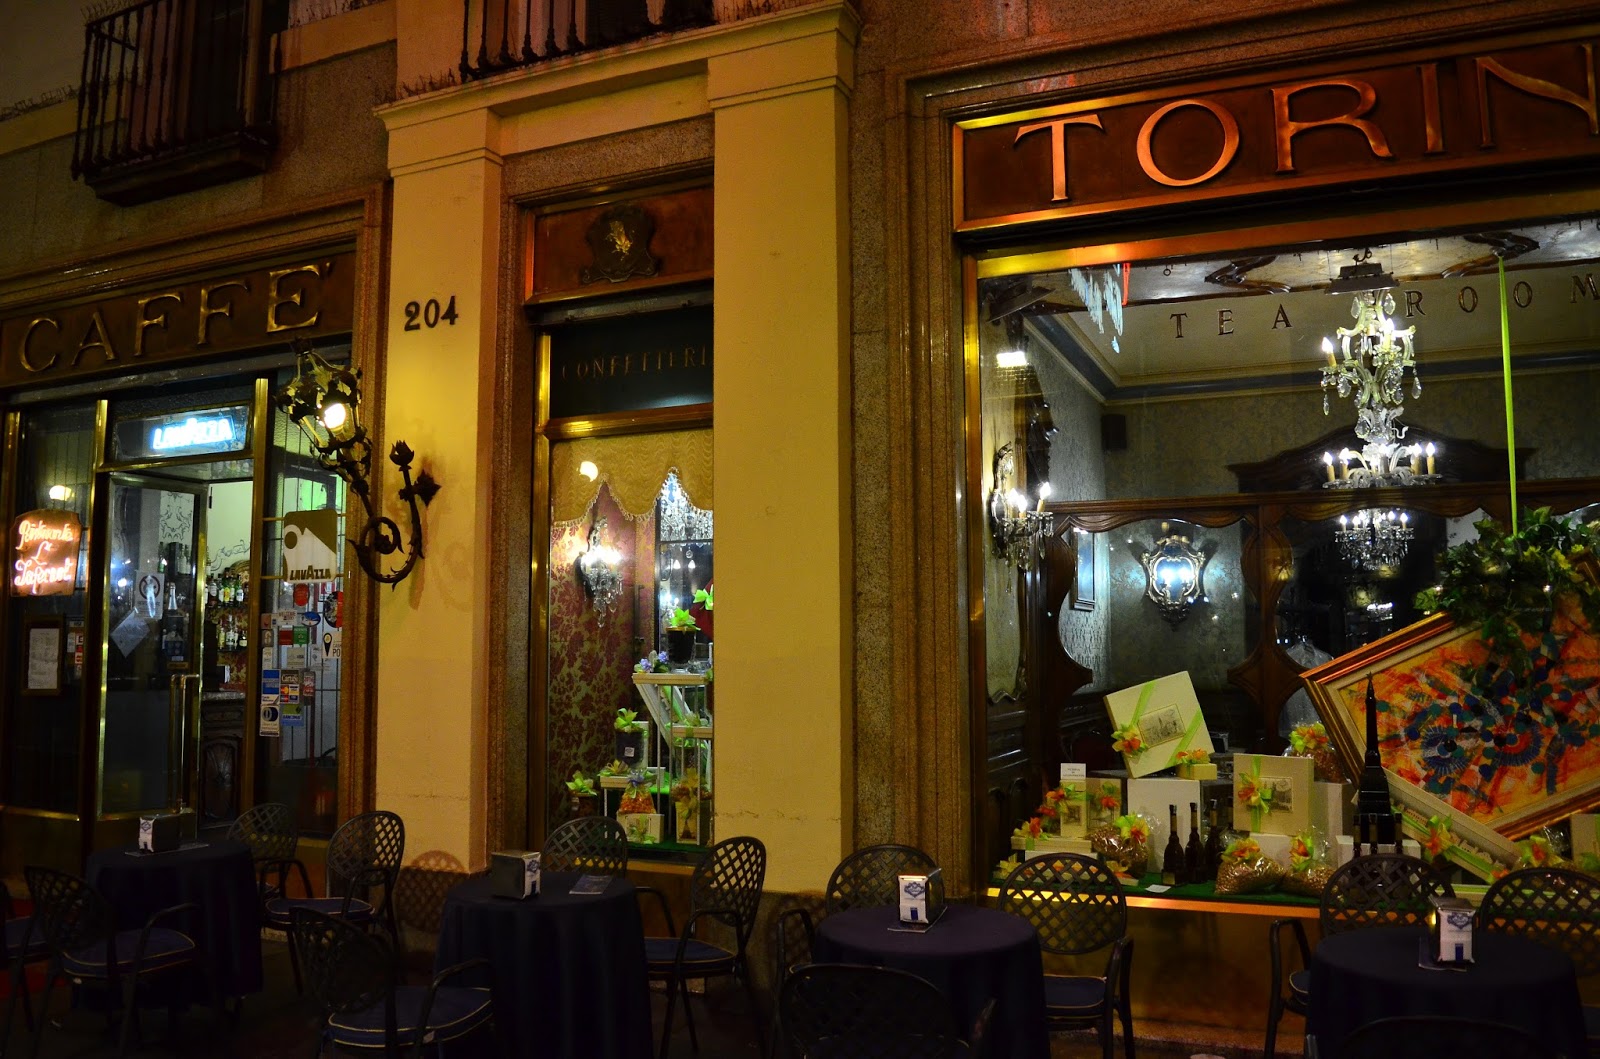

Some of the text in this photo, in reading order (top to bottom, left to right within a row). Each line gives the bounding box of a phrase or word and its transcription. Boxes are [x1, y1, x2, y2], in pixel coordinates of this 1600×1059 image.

[1013, 43, 1600, 202] TORIN
[403, 295, 459, 332] 204
[1169, 303, 1293, 339] TEA
[1404, 273, 1600, 319] ROOM
[562, 343, 712, 380] CONFETTERI
[153, 417, 233, 450] LAVAZZA
[289, 564, 332, 580] LAVAZZA
